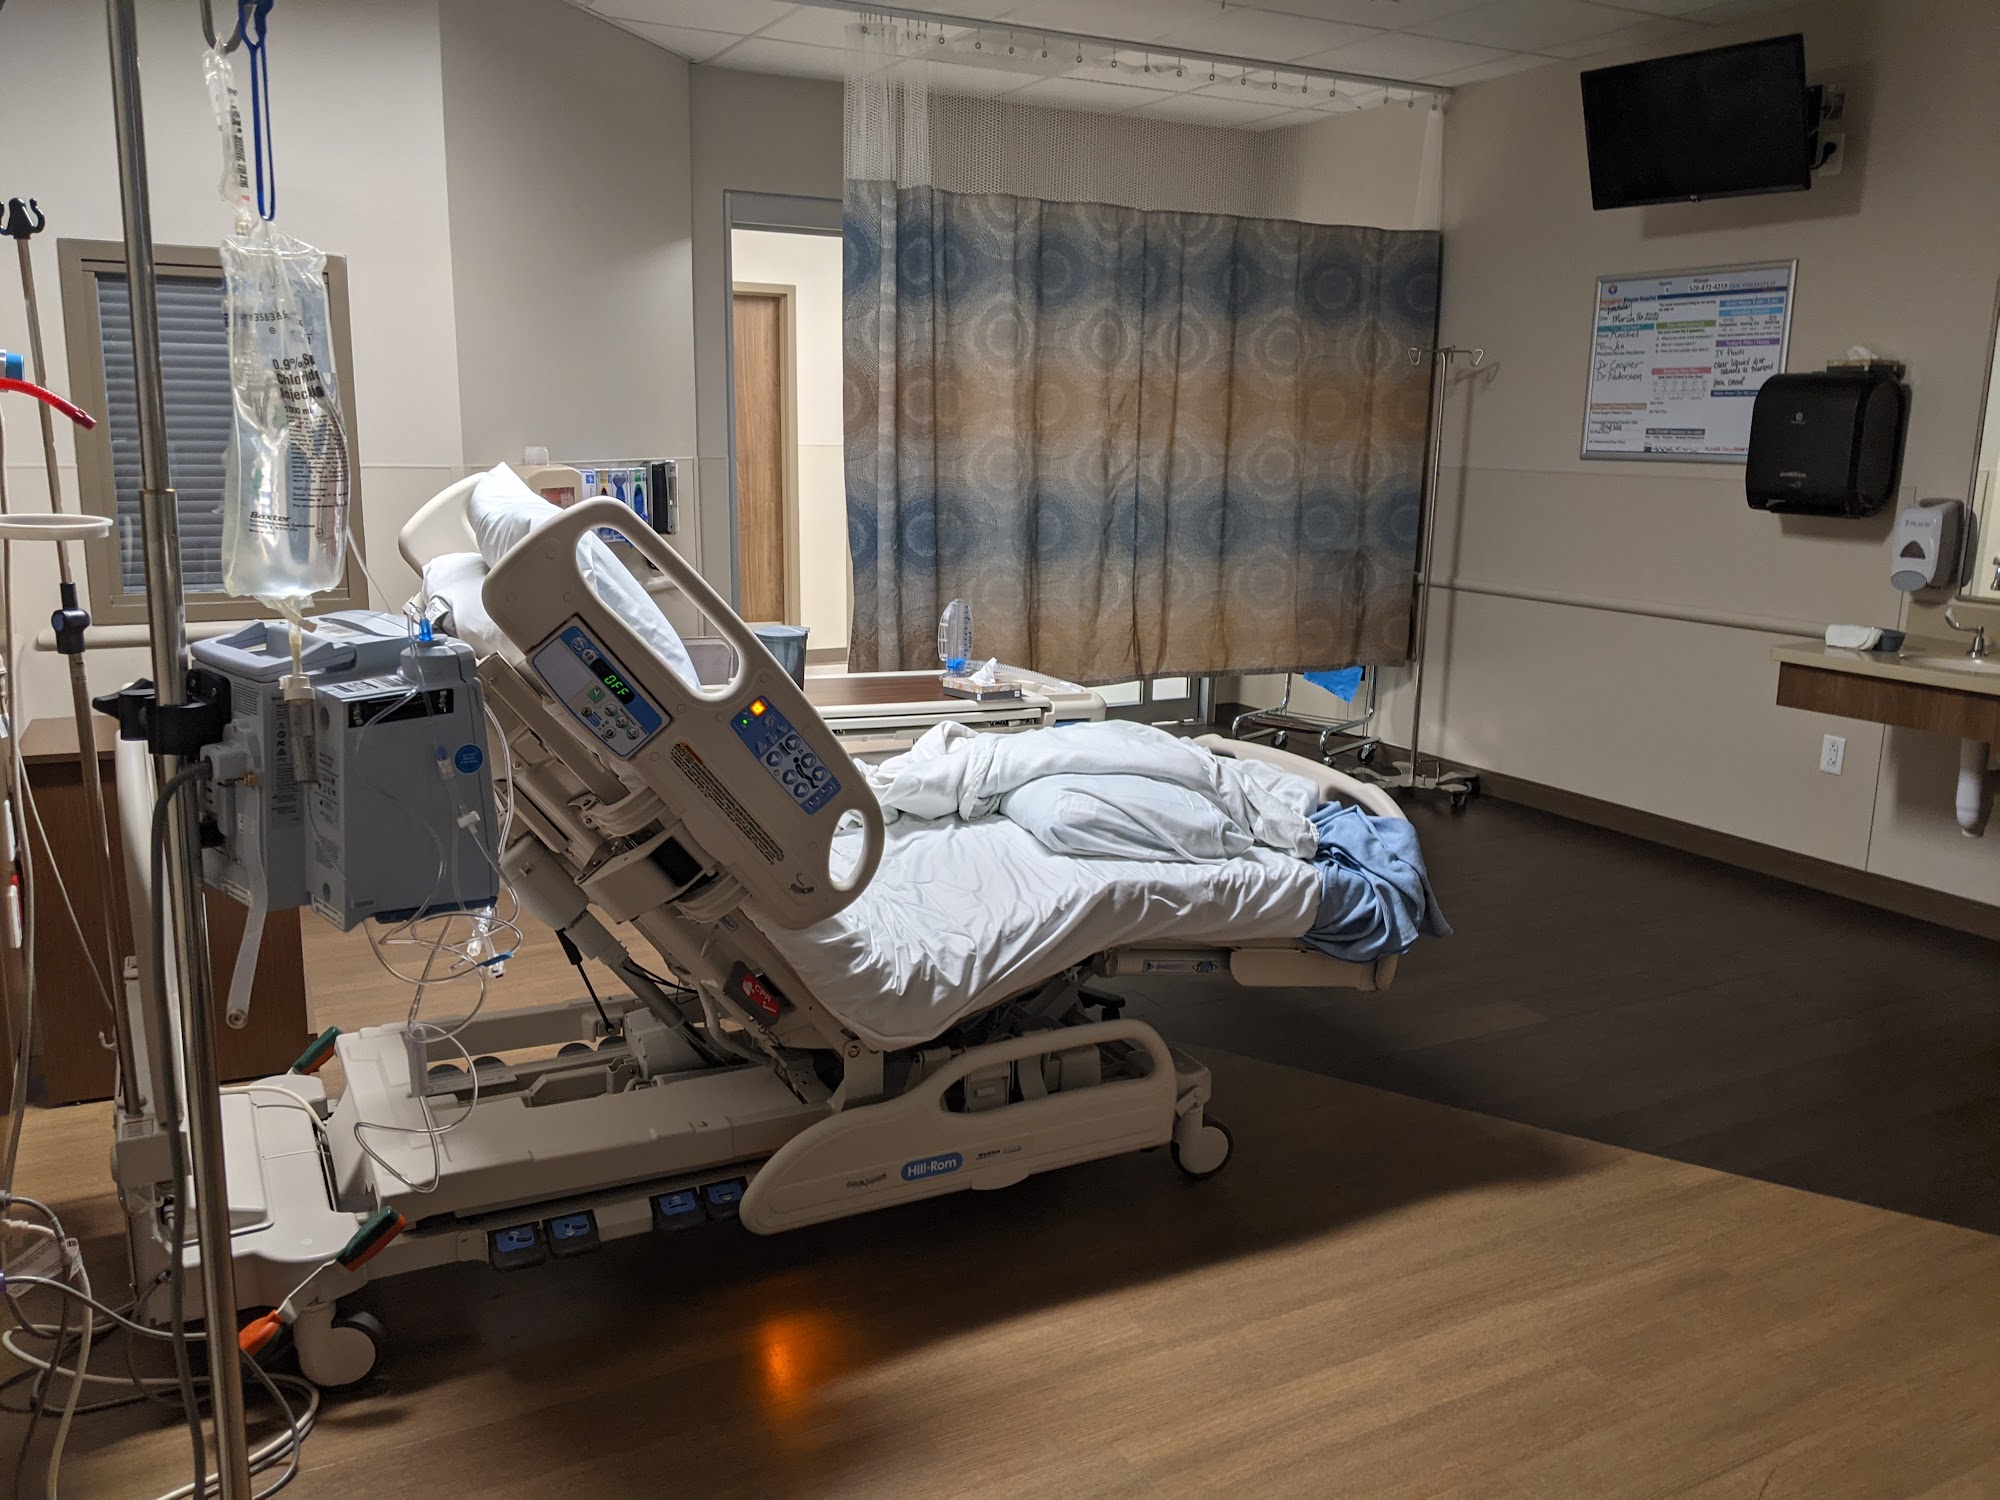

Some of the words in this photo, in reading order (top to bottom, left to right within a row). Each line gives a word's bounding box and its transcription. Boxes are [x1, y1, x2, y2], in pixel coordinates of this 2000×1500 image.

[272, 356, 303, 371] 0.9%
[250, 511, 291, 522] Baxter
[604, 673, 629, 697] OFF
[907, 1157, 957, 1177] Hill-Rom
